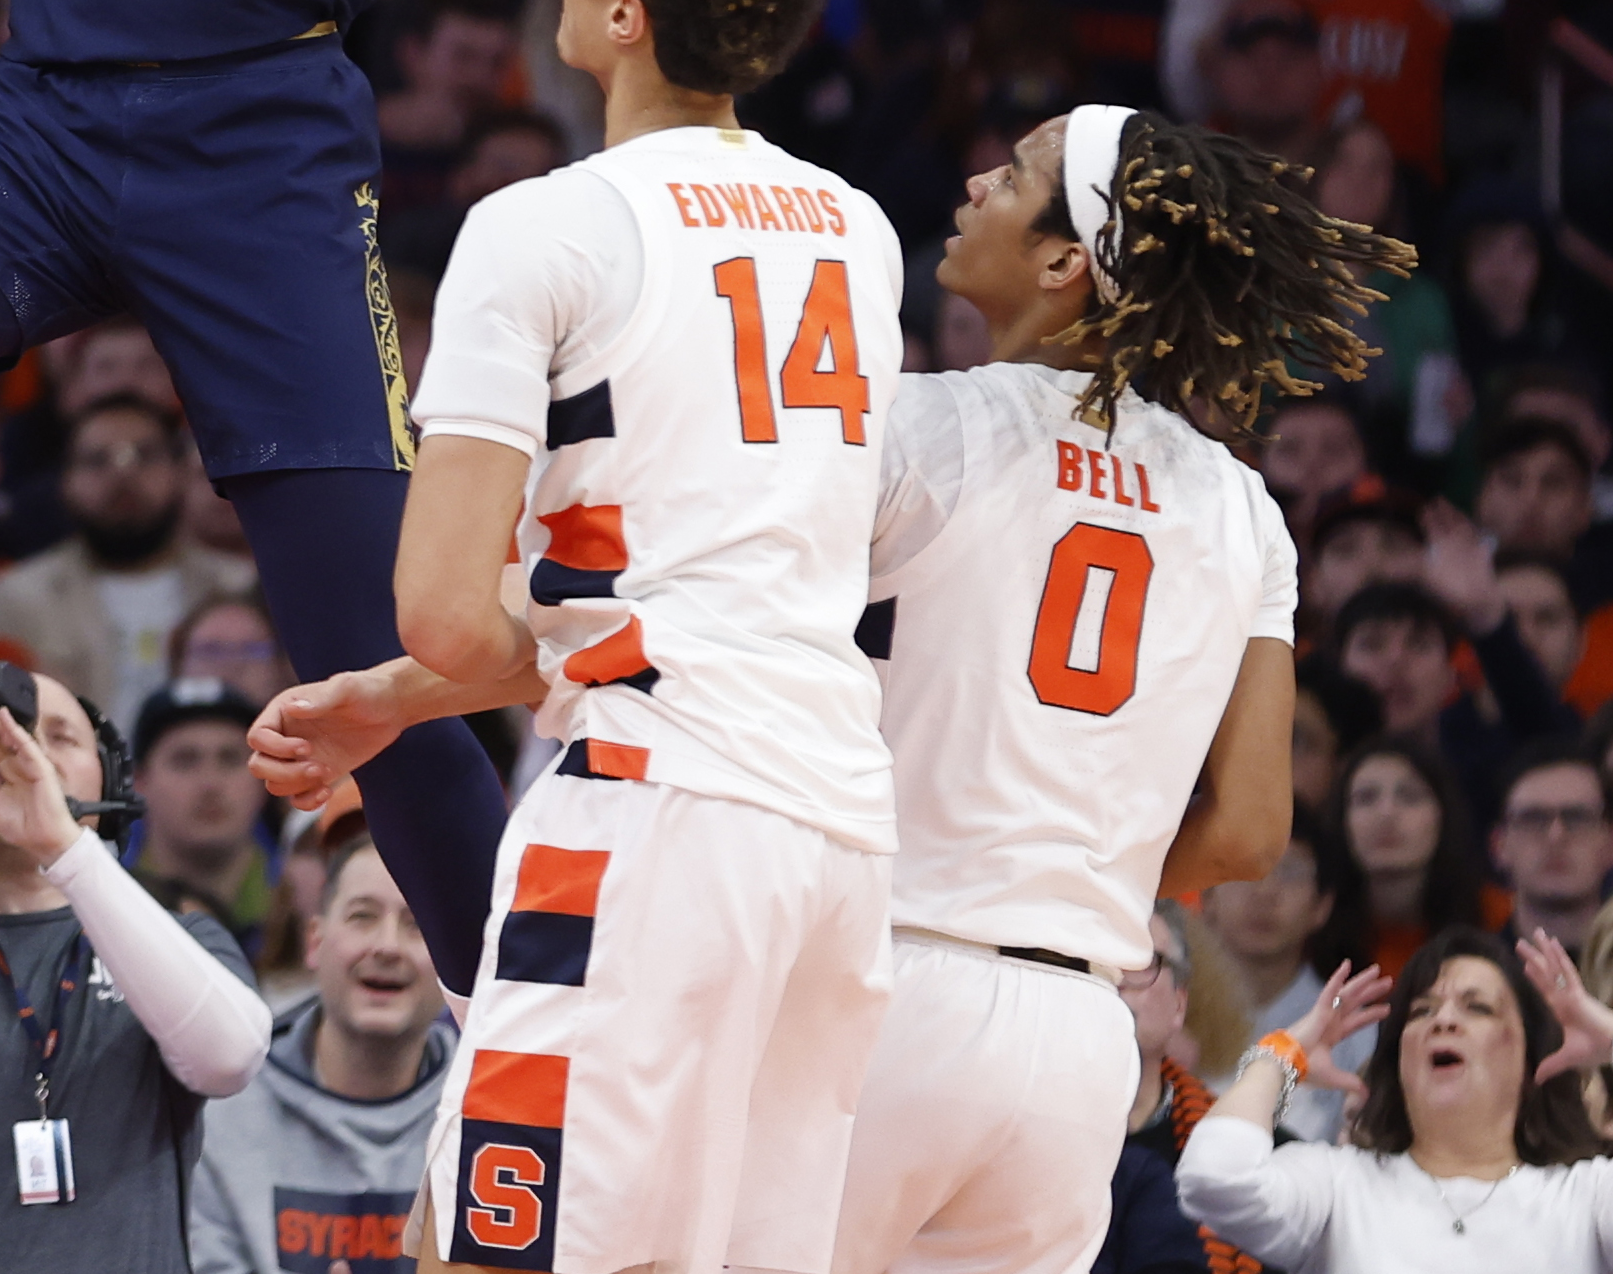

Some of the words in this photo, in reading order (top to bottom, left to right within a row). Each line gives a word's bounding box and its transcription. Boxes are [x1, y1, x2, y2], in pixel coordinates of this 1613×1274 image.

[666, 182, 848, 237] EDWARDS
[712, 256, 871, 448] 14
[1056, 439, 1161, 514] BELL
[1027, 521, 1155, 717] 0
[466, 1142, 546, 1251] S
